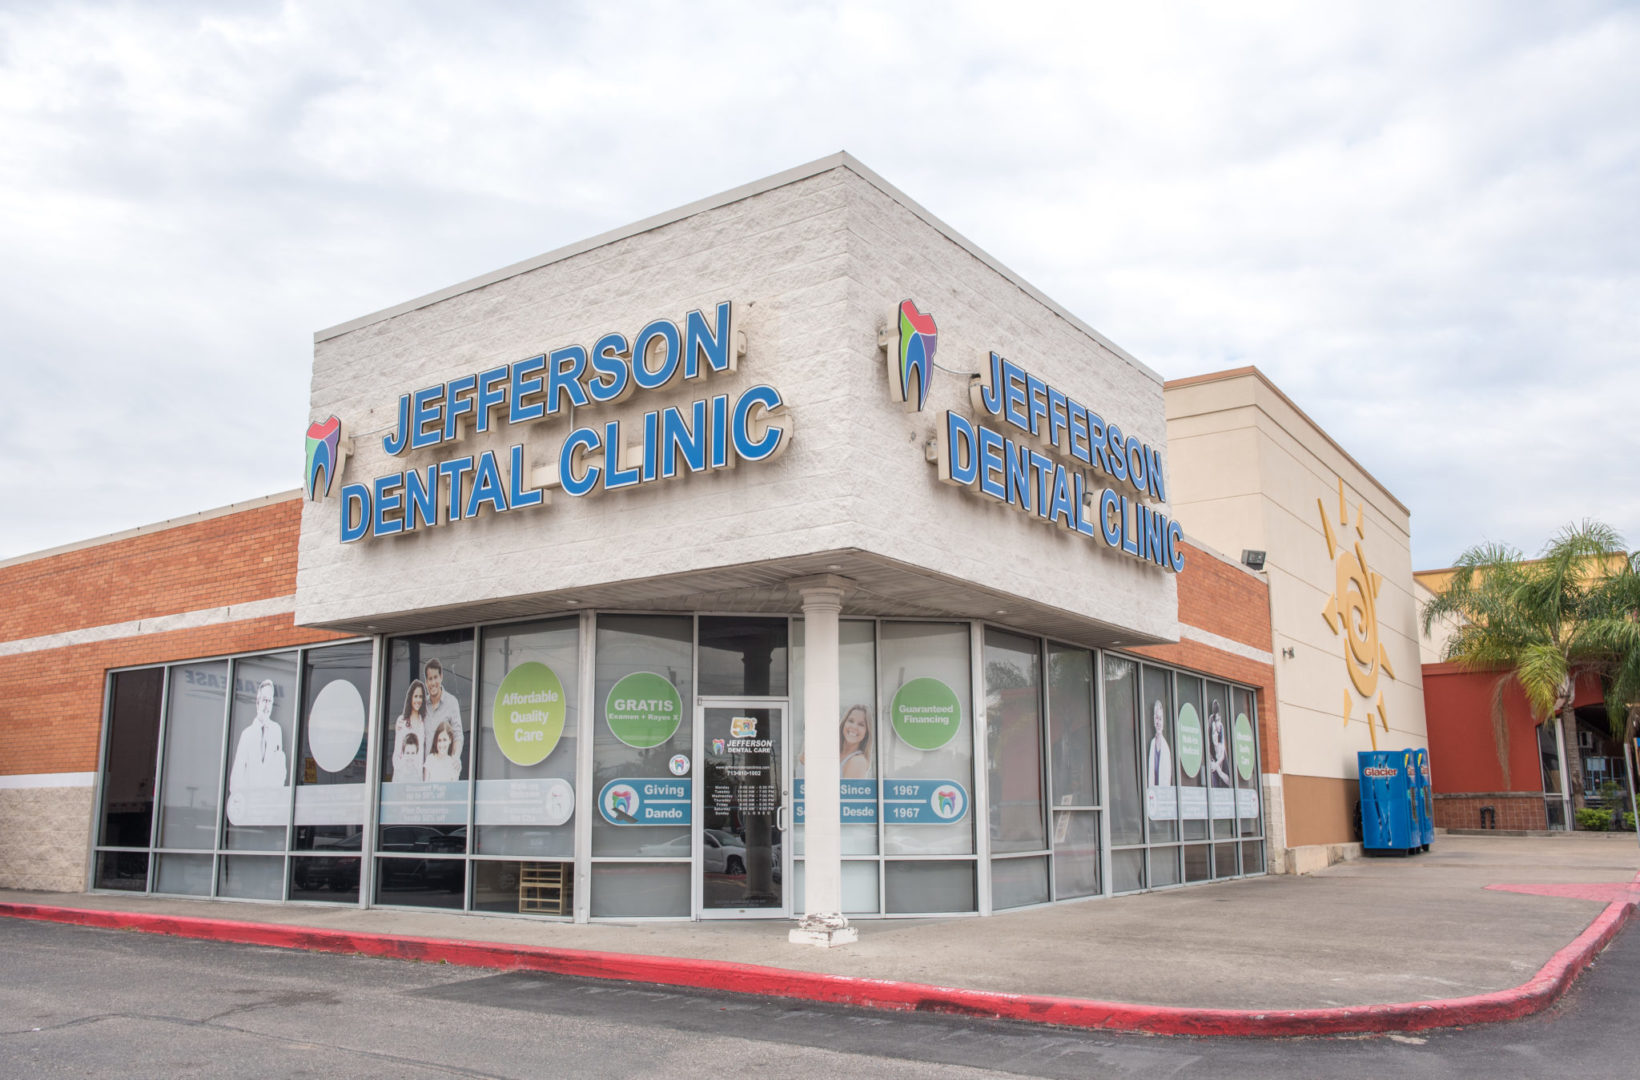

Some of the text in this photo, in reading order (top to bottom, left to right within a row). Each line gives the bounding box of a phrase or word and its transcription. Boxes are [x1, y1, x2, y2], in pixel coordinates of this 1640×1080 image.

[382, 300, 732, 456] JEFFERSON
[980, 351, 1166, 502] JEFFERSON
[340, 384, 785, 545] DENTAL CLINIC
[947, 410, 1185, 573] DENTAL CLINIC
[502, 690, 558, 706] Affordable
[614, 699, 674, 712] GRATIS
[898, 704, 954, 713] Guaranteed
[510, 710, 549, 725] Quality
[904, 715, 950, 725] Financing
[514, 728, 544, 742] Care
[726, 739, 773, 747] JEFFERSON
[1364, 768, 1397, 777] Glacier
[644, 784, 685, 798] Giving
[840, 784, 920, 796] Since 1967
[645, 808, 683, 819] Dando
[842, 806, 920, 818] Desde 1967
